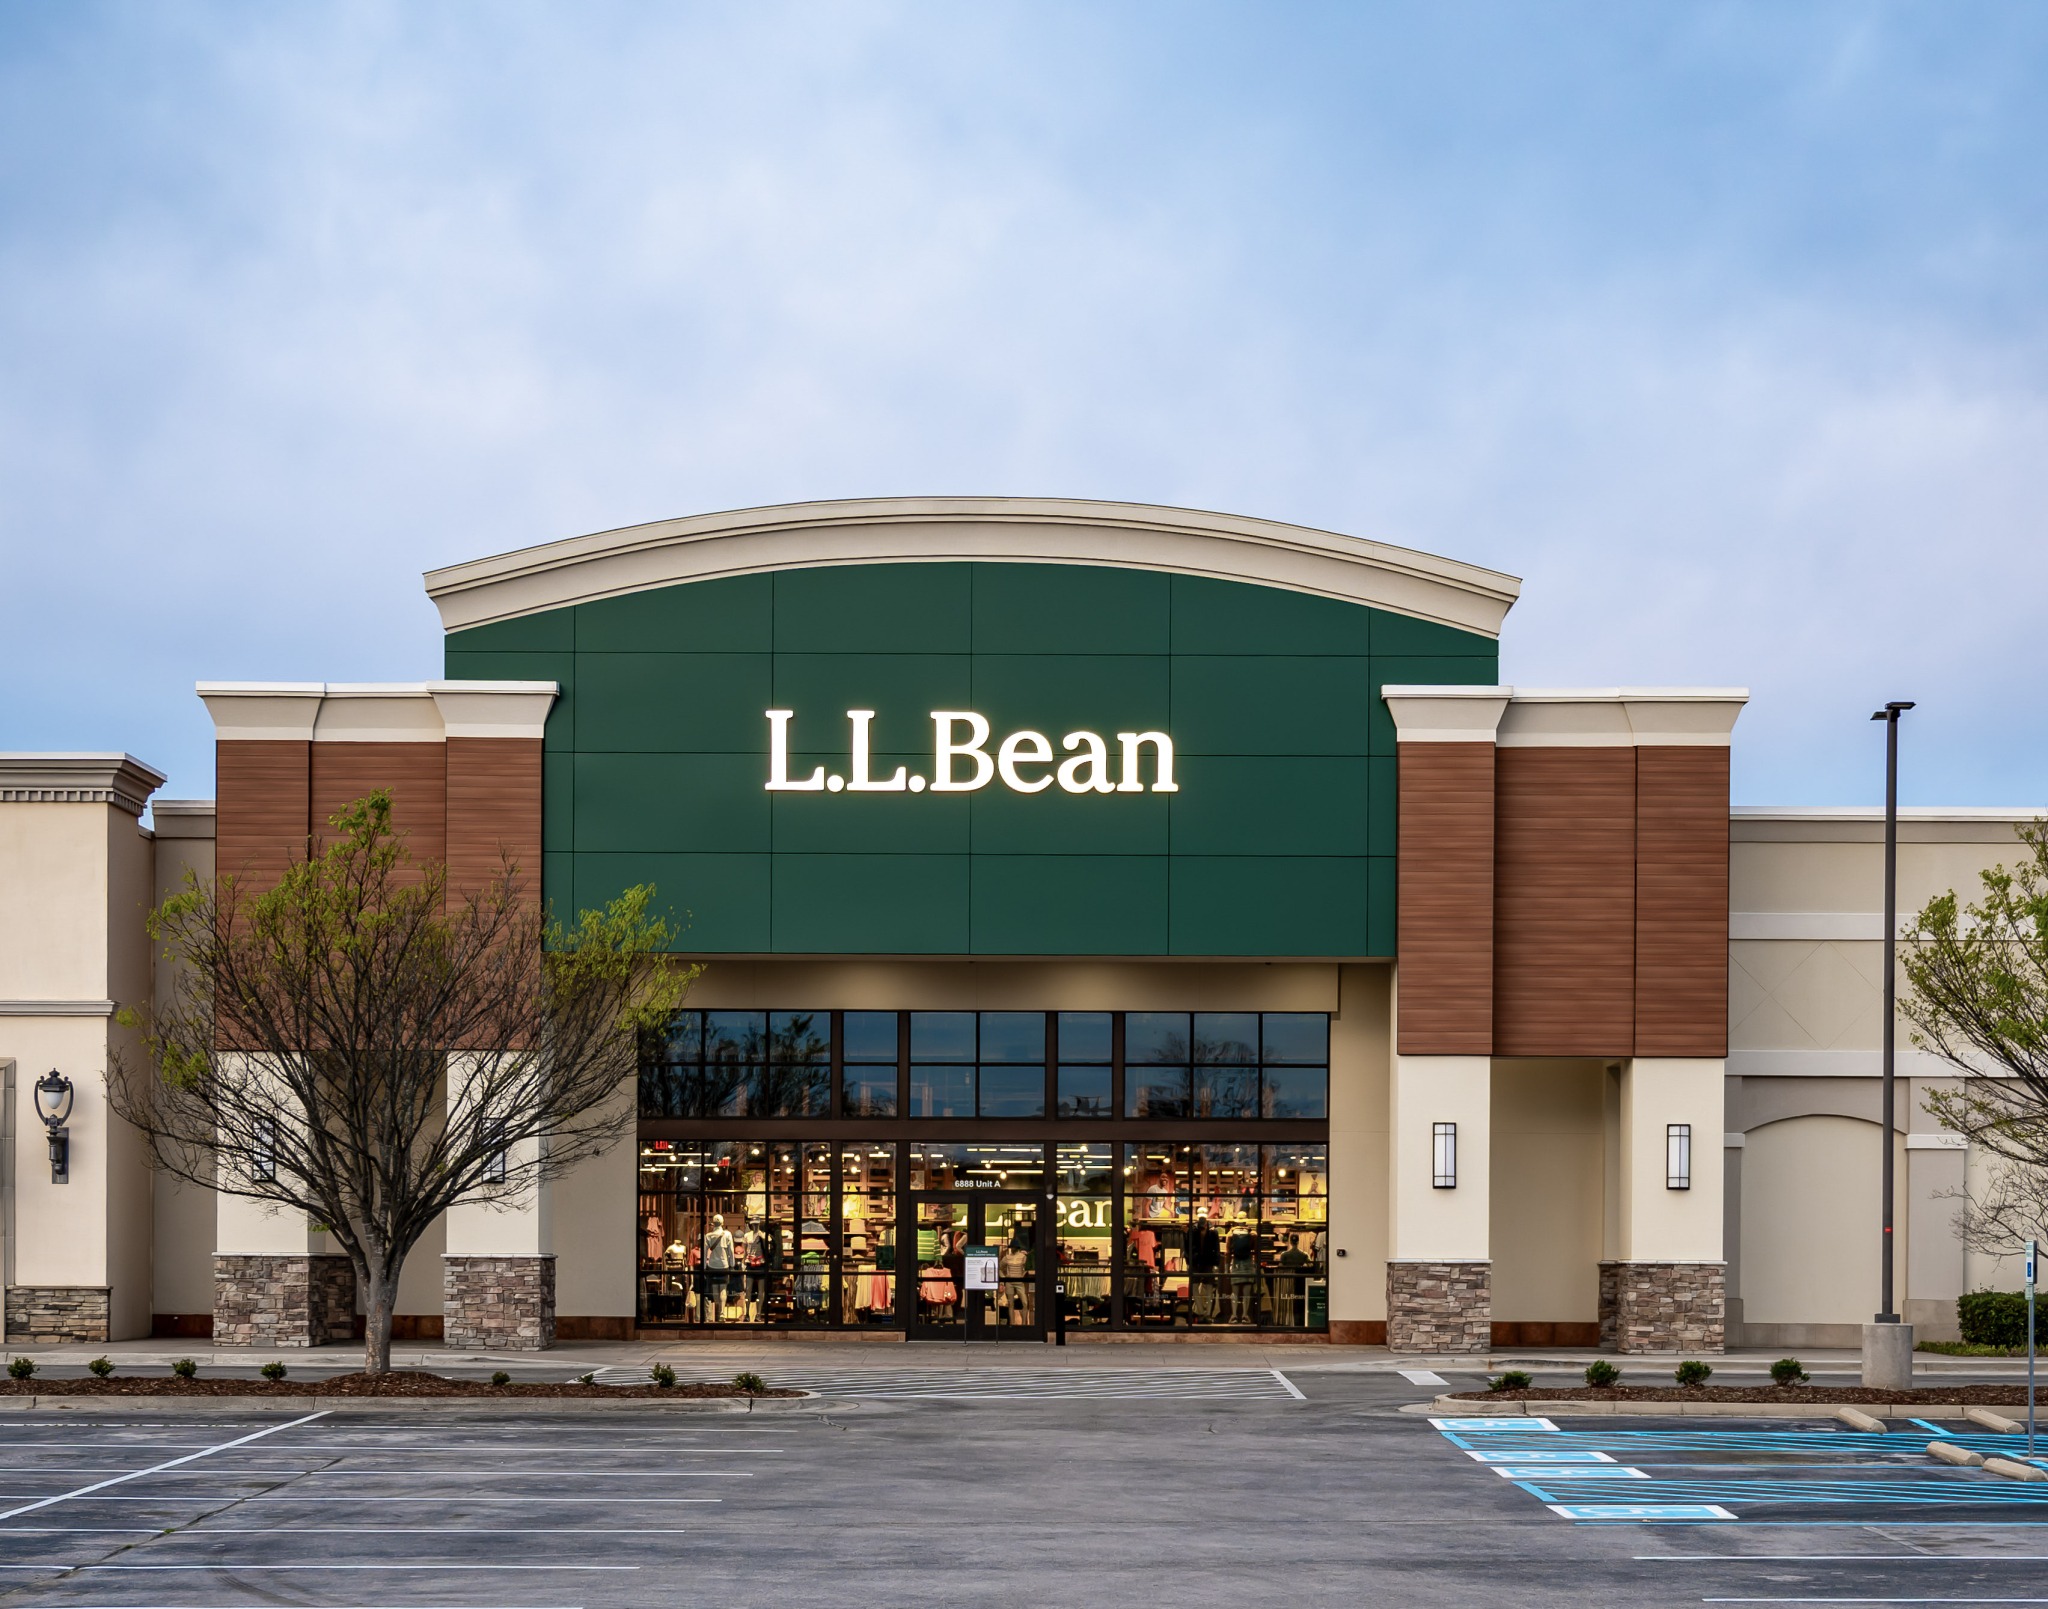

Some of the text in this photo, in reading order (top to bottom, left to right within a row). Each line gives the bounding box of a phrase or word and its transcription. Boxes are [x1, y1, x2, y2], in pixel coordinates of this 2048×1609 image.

[764, 710, 1179, 793] L.L.Bean
[954, 1180, 1001, 1188] 6888 Unit A
